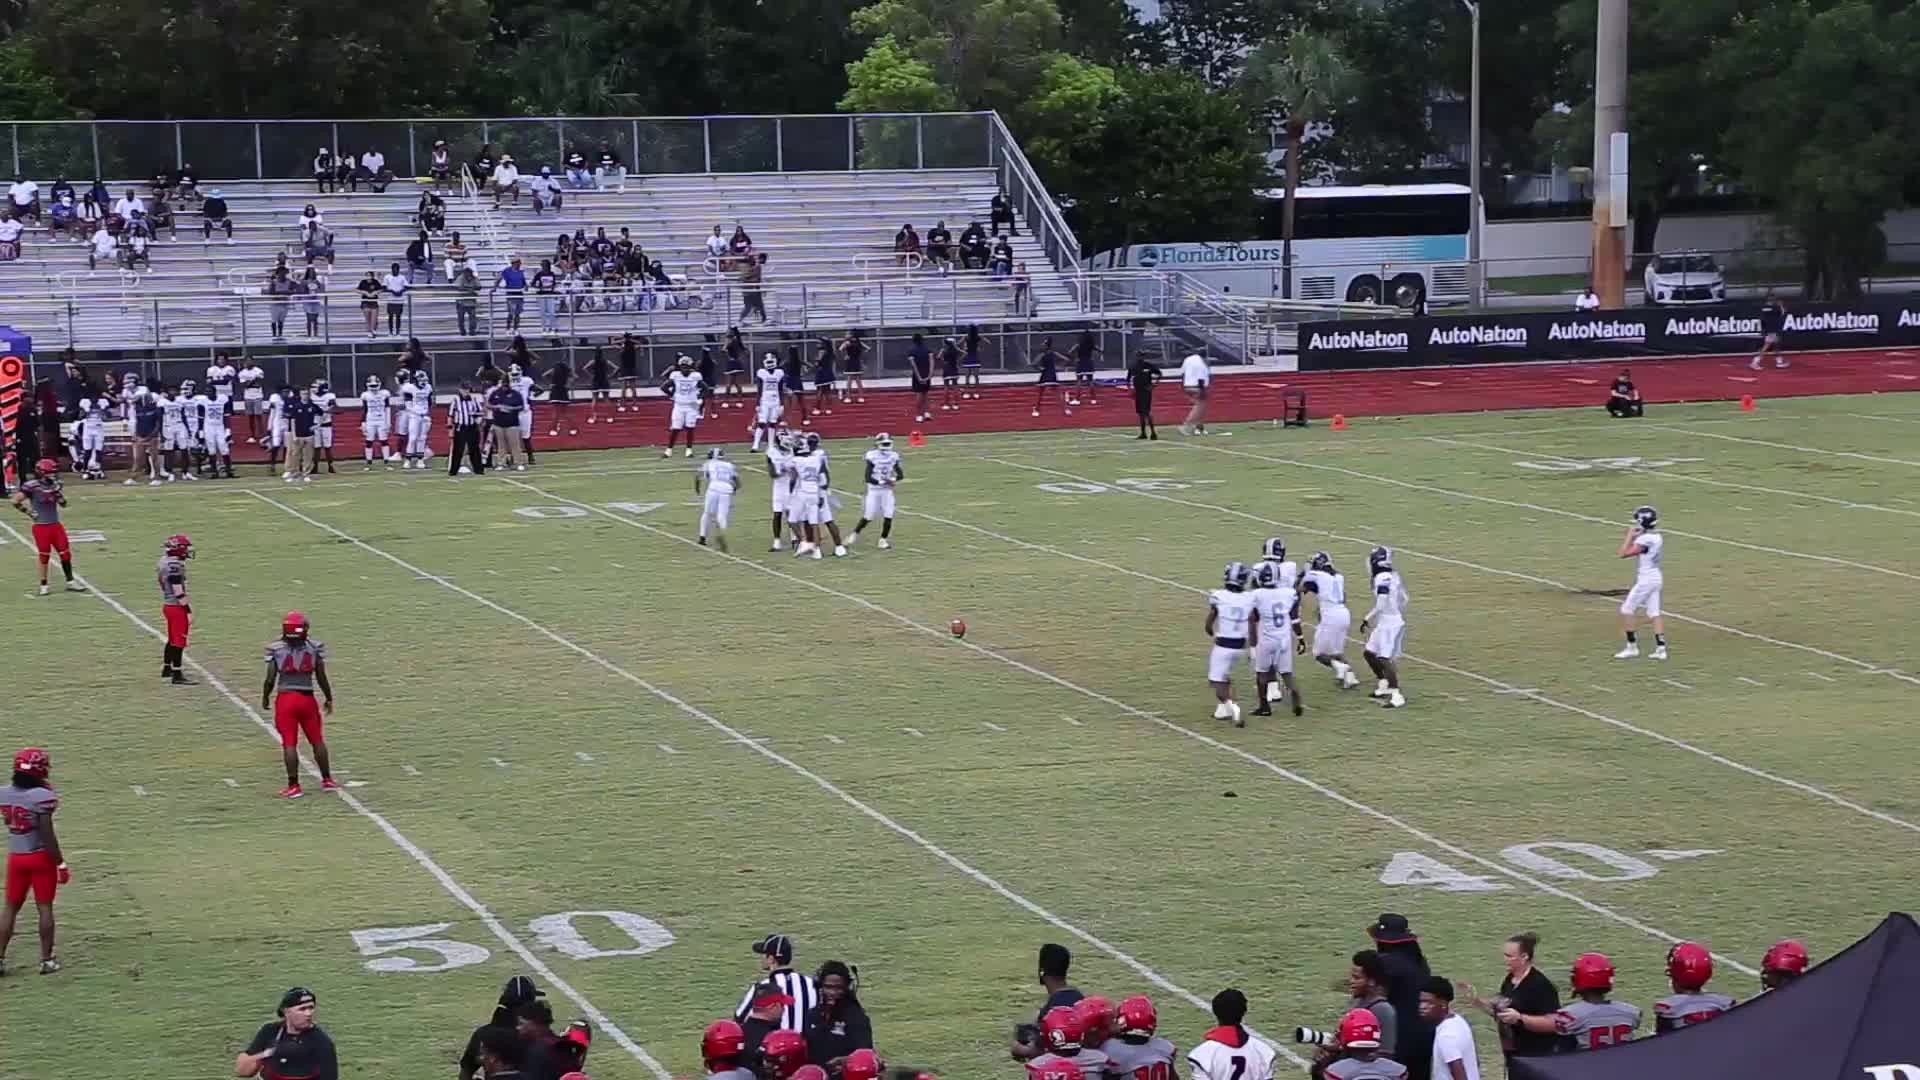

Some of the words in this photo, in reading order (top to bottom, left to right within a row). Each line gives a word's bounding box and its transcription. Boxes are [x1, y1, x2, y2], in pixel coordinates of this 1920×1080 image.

[1548, 319, 1646, 342] AutoNation
[1665, 316, 1762, 336] AutoNation
[1783, 312, 1879, 332] AutoNation
[1308, 331, 1408, 351] AutoNation
[1428, 325, 1527, 347] AutoNation
[1271, 601, 1287, 629] 6
